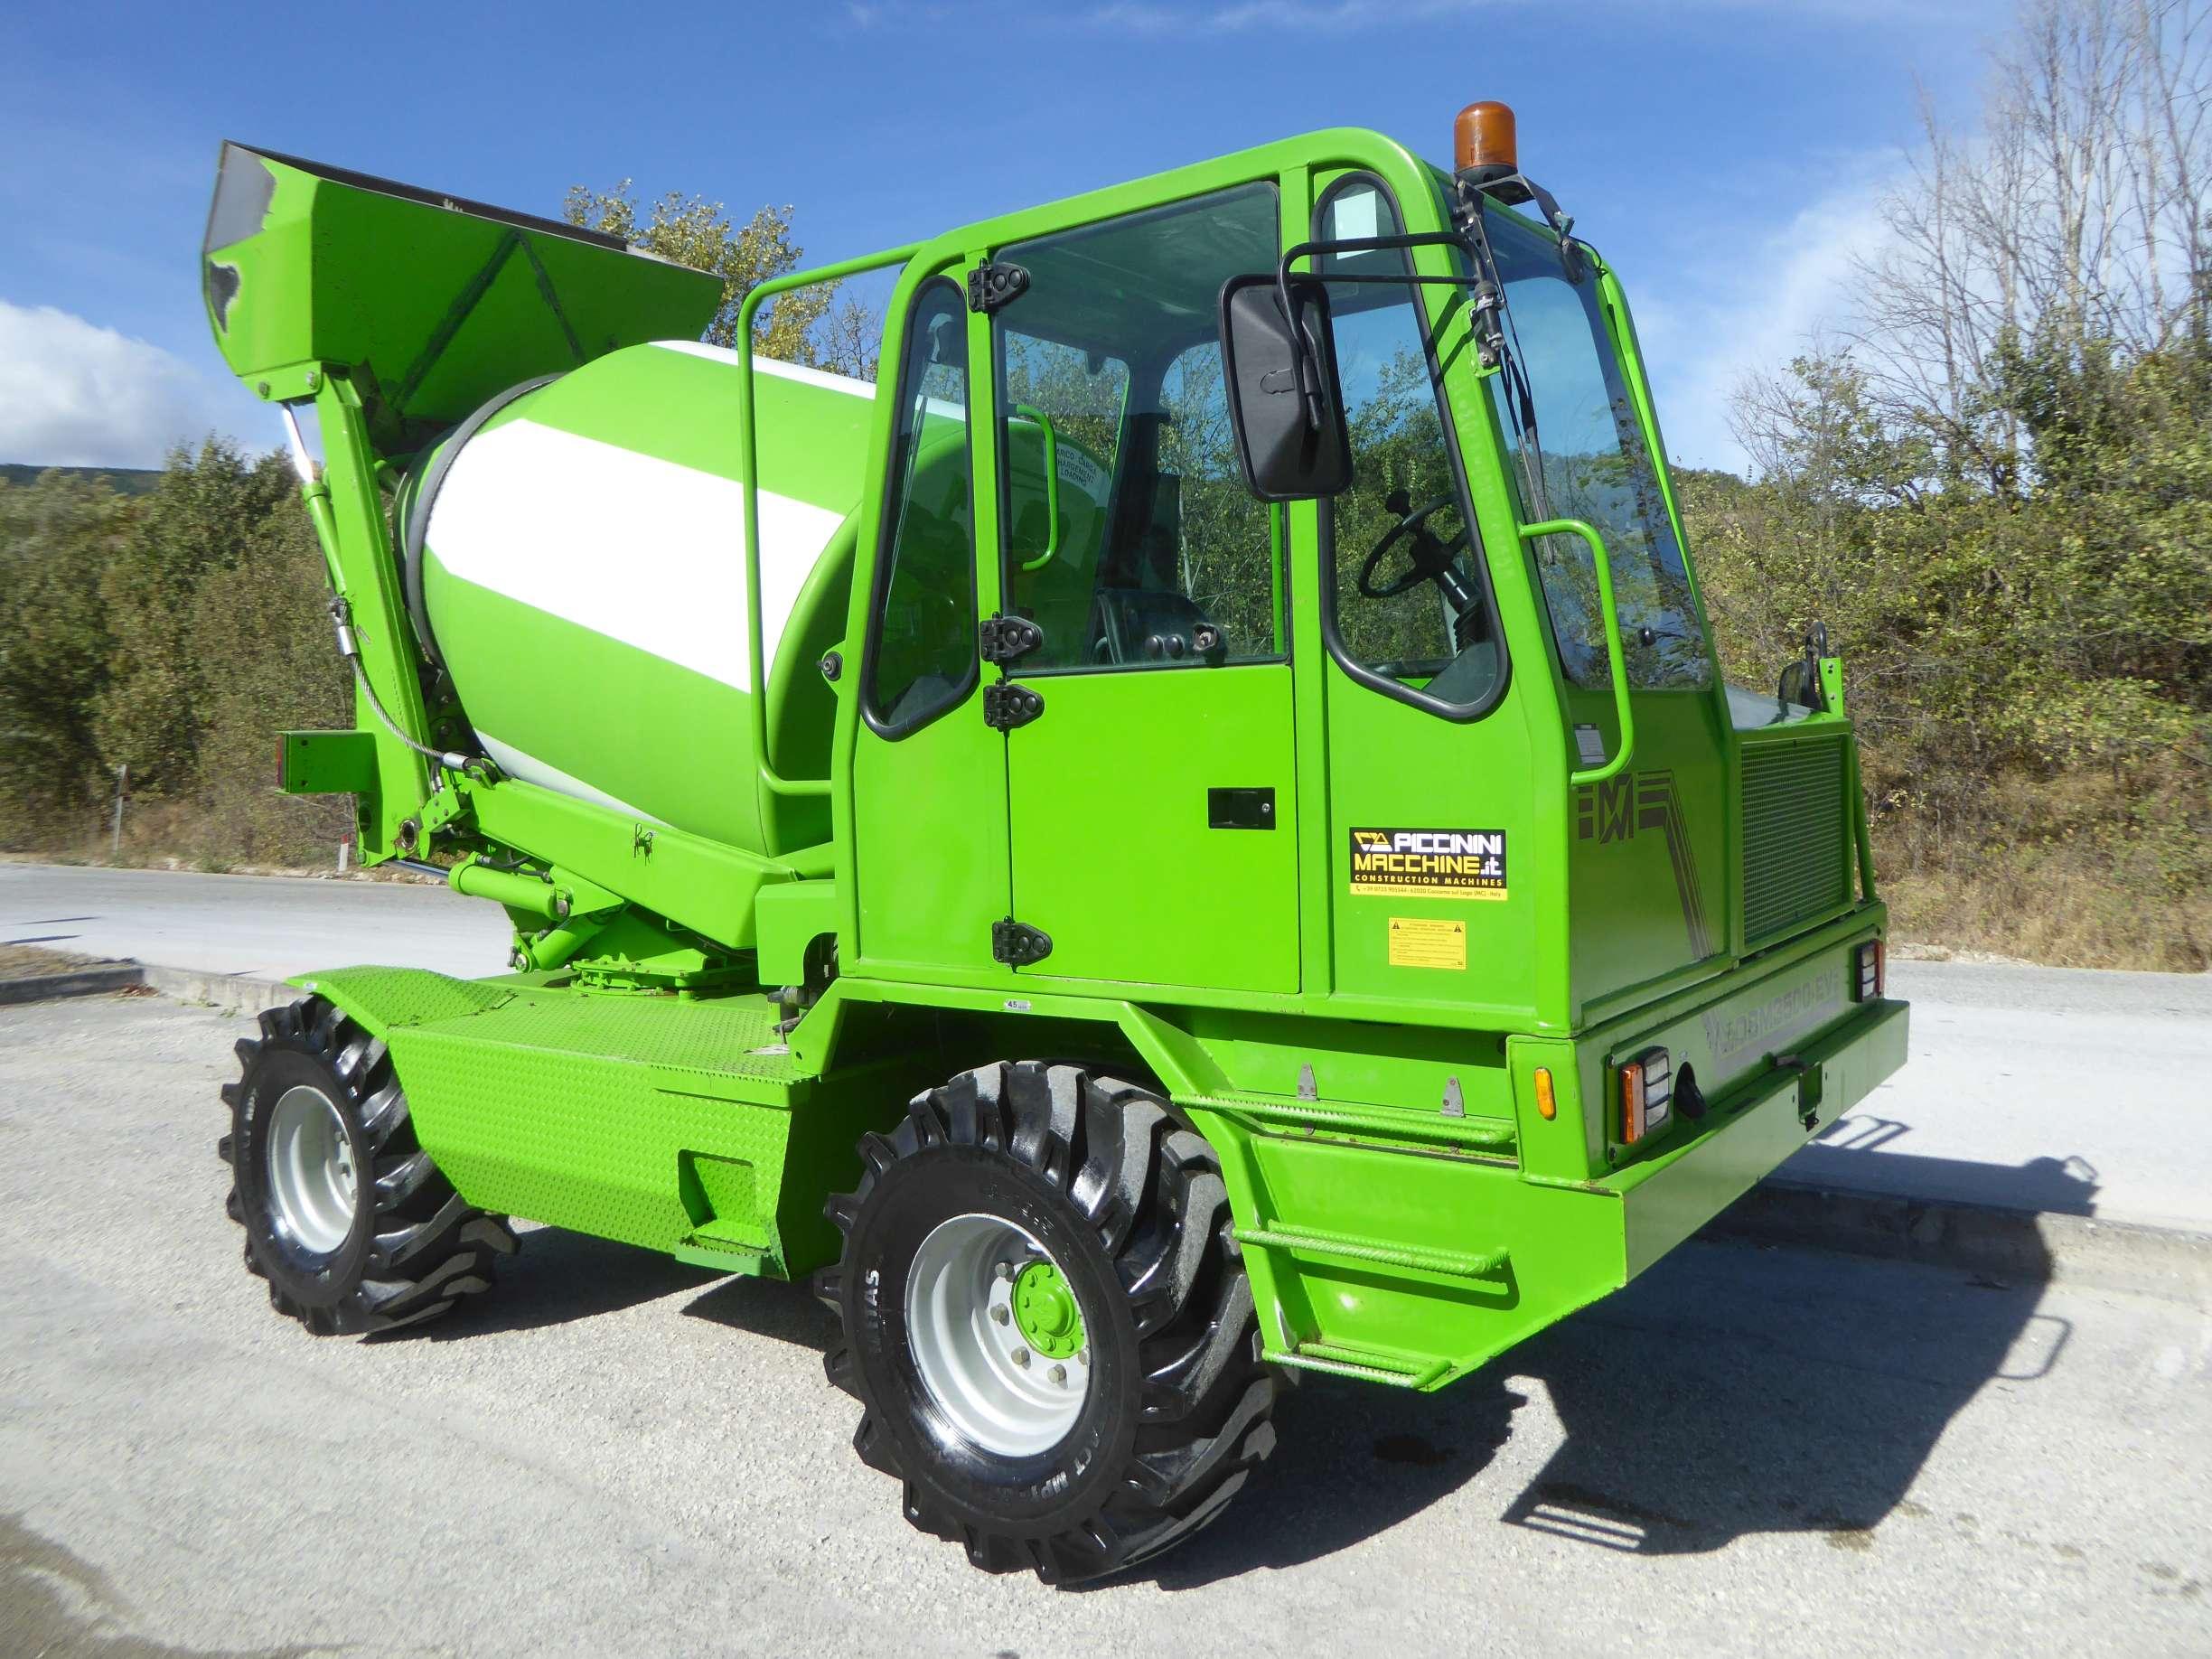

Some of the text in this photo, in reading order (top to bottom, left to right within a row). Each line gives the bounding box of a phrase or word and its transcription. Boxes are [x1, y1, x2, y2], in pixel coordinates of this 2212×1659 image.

[1056, 447, 1074, 460] ARICO
[1057, 459, 1094, 485] HARGEMENT
[1061, 469, 1087, 486] LOADING
[1393, 832, 1502, 855] PICCININI
[1354, 853, 1502, 876] MACCHINE.it
[1354, 874, 1503, 886] CONSTRUCTION MACHINES
